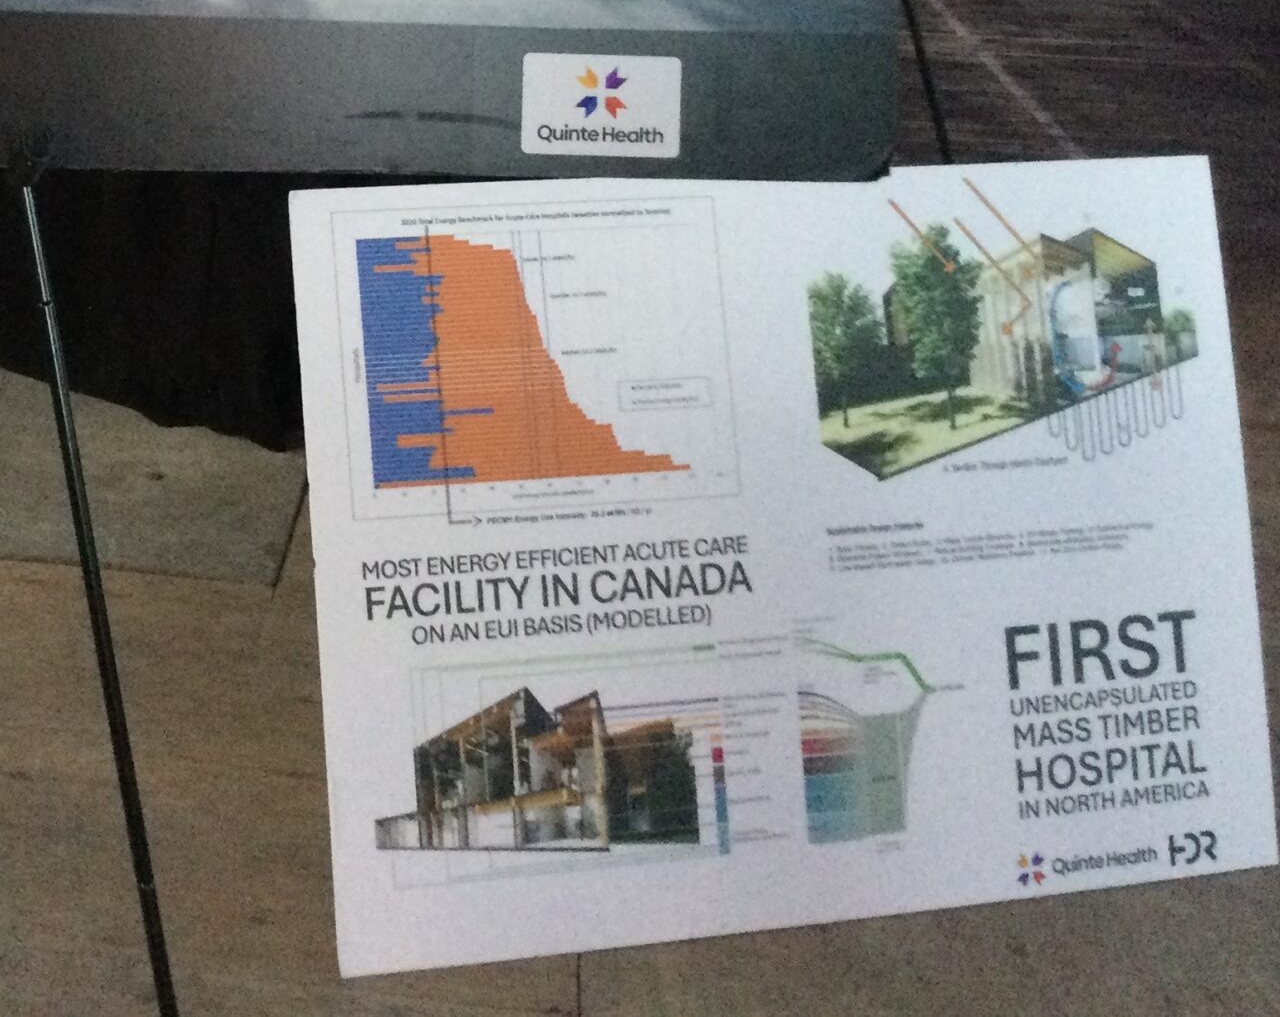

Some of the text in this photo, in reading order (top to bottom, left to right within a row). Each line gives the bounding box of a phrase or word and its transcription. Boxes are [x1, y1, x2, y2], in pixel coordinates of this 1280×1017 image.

[537, 124, 664, 144] Quinte Health
[361, 535, 749, 581] MOST ENERGY EFFICIENT ACUTE CARE
[364, 561, 753, 622] FACILITY IN CANADA
[411, 607, 712, 645] ON AN EUI BASIS (MODELLED)
[1004, 610, 1195, 691] FIRST
[1010, 680, 1197, 717] UNENCAPSULATED
[1013, 706, 1201, 750] MASS TIMBER
[1014, 740, 1207, 794] HOSPITAL
[1018, 782, 1210, 820] IN NORTH AMERICA
[1052, 829, 1218, 876] Quinte Health HDR
